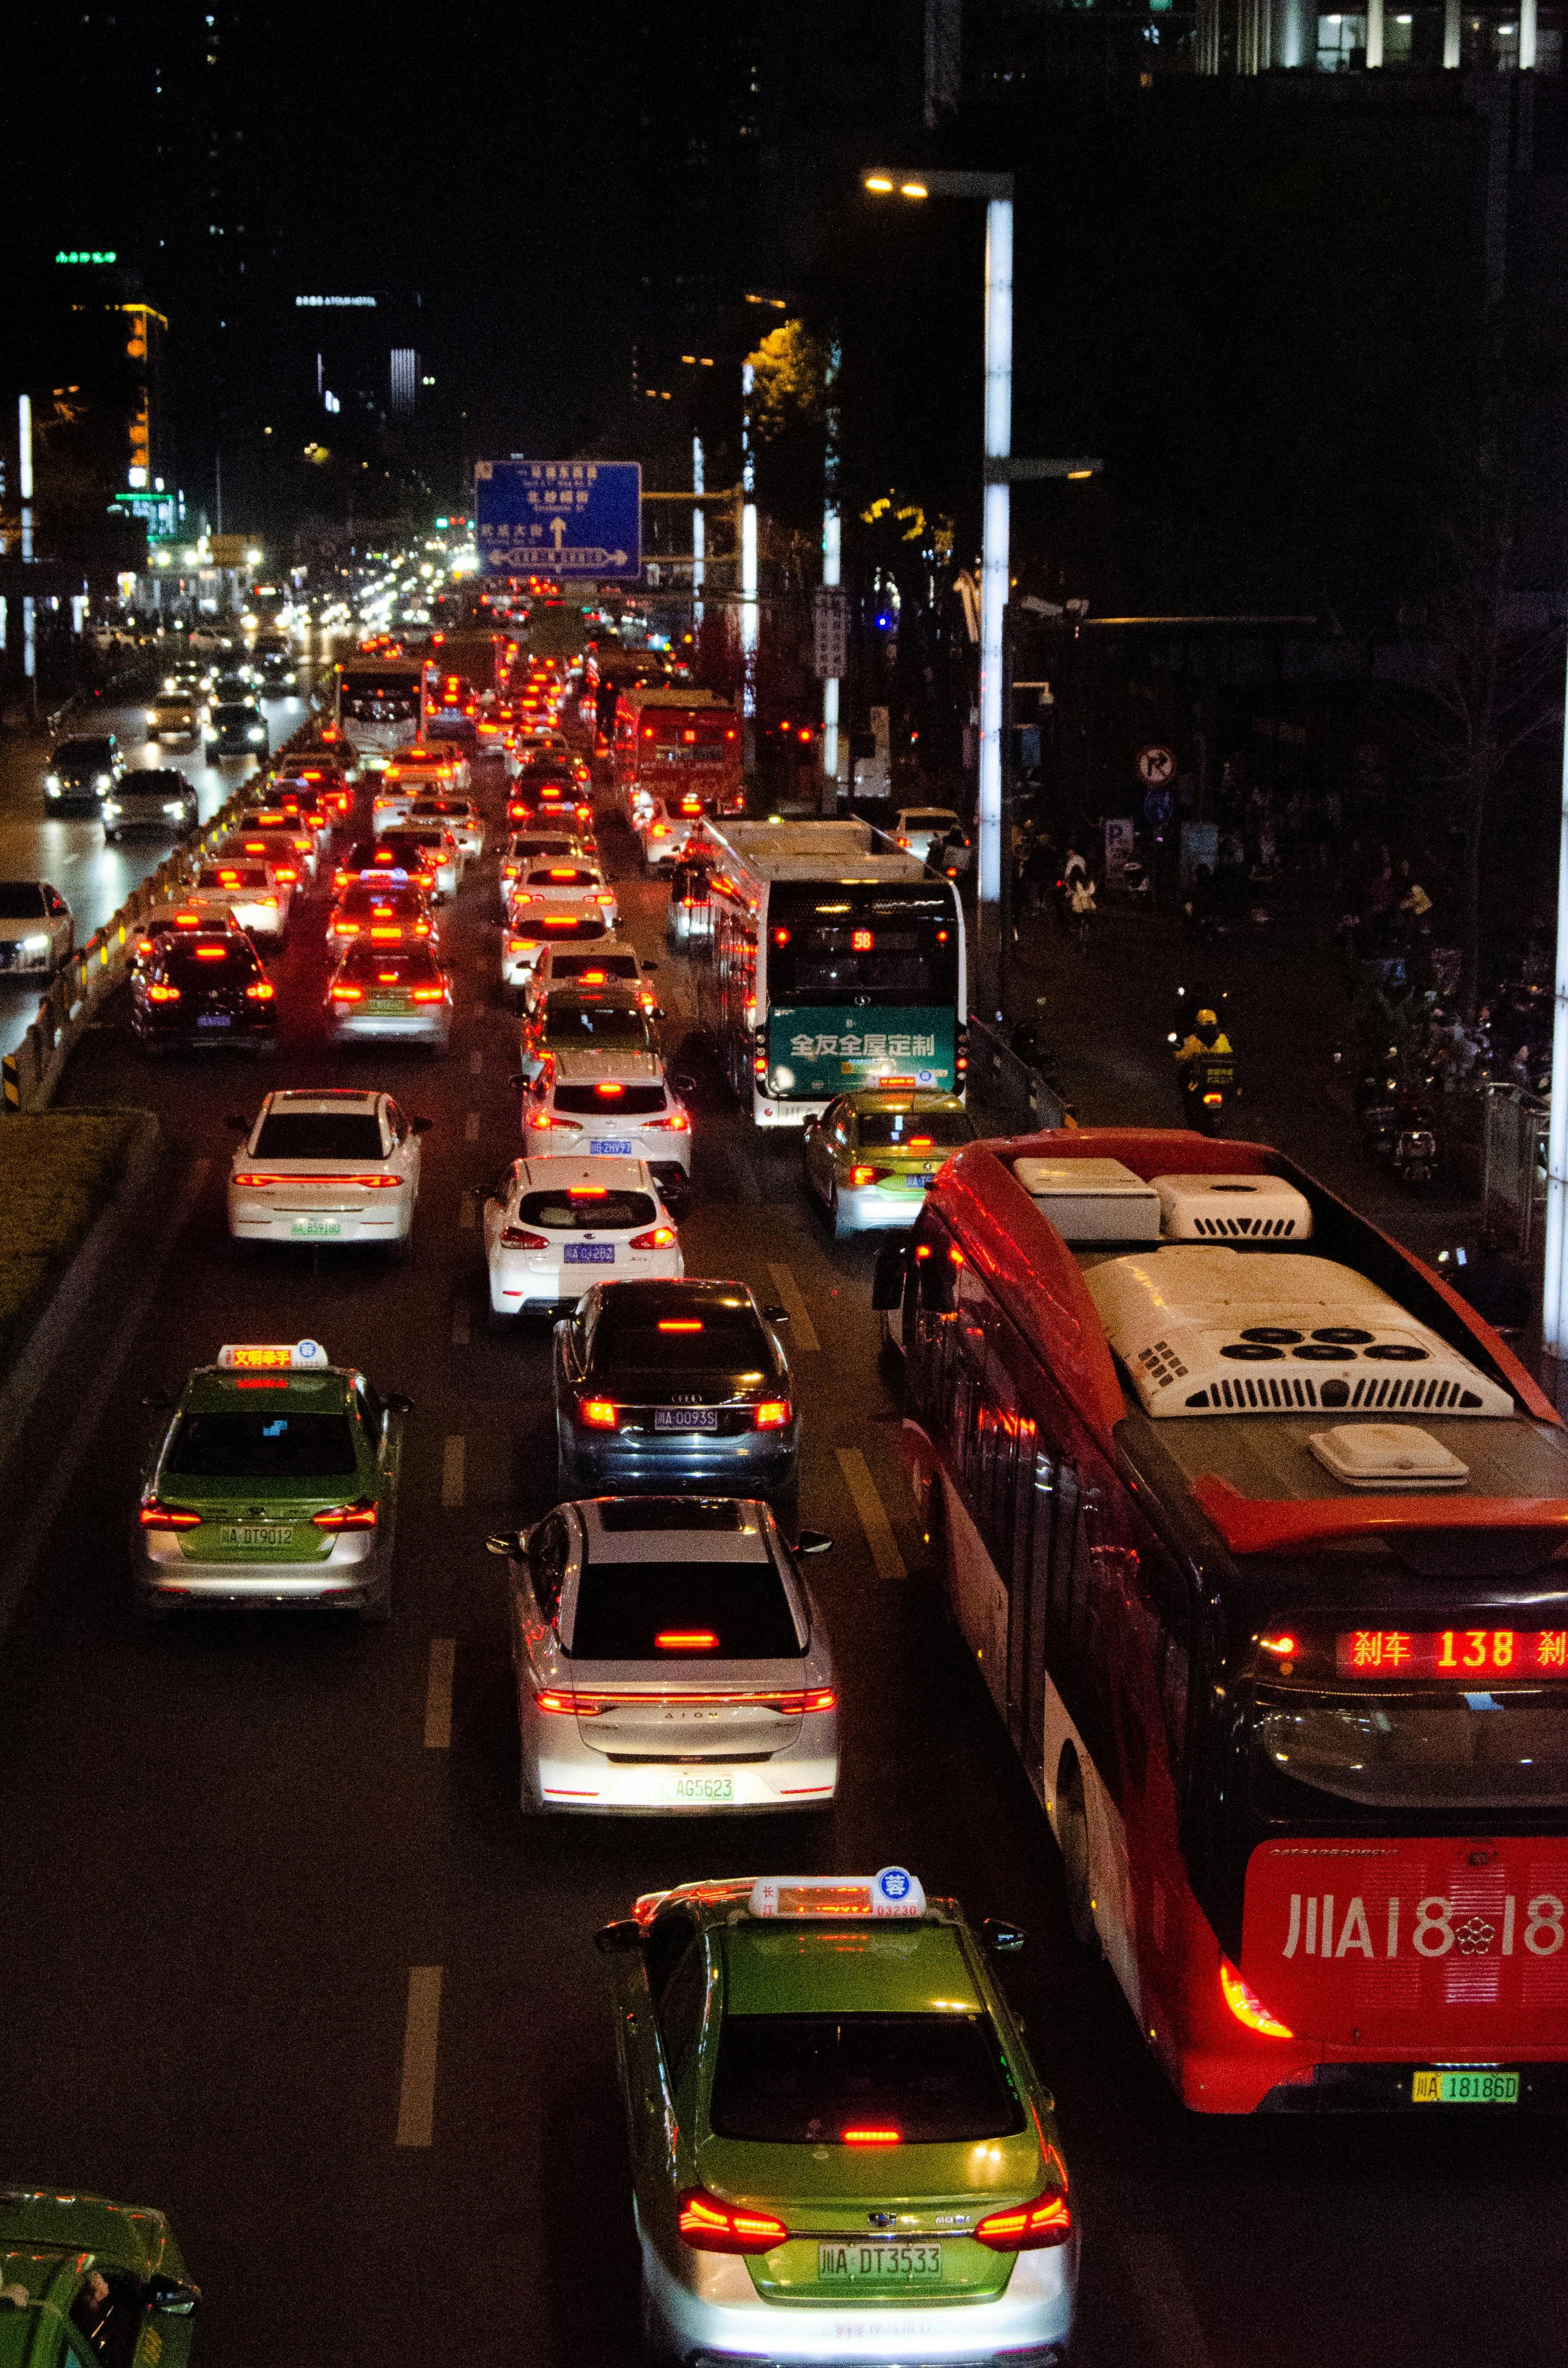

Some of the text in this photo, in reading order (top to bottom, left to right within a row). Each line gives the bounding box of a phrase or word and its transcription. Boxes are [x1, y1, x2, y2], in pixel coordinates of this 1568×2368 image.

[854, 932, 871, 949] 58
[791, 1033, 935, 1057] 全友全屋定制
[1353, 1632, 1568, 1666] 刹车 138 刹
[676, 1779, 732, 1797] AG5623
[884, 1873, 907, 1896] 蓉
[877, 1906, 917, 1916] 03230
[1449, 2077, 1516, 2098] 18186D
[860, 2248, 939, 2274] DT3533
